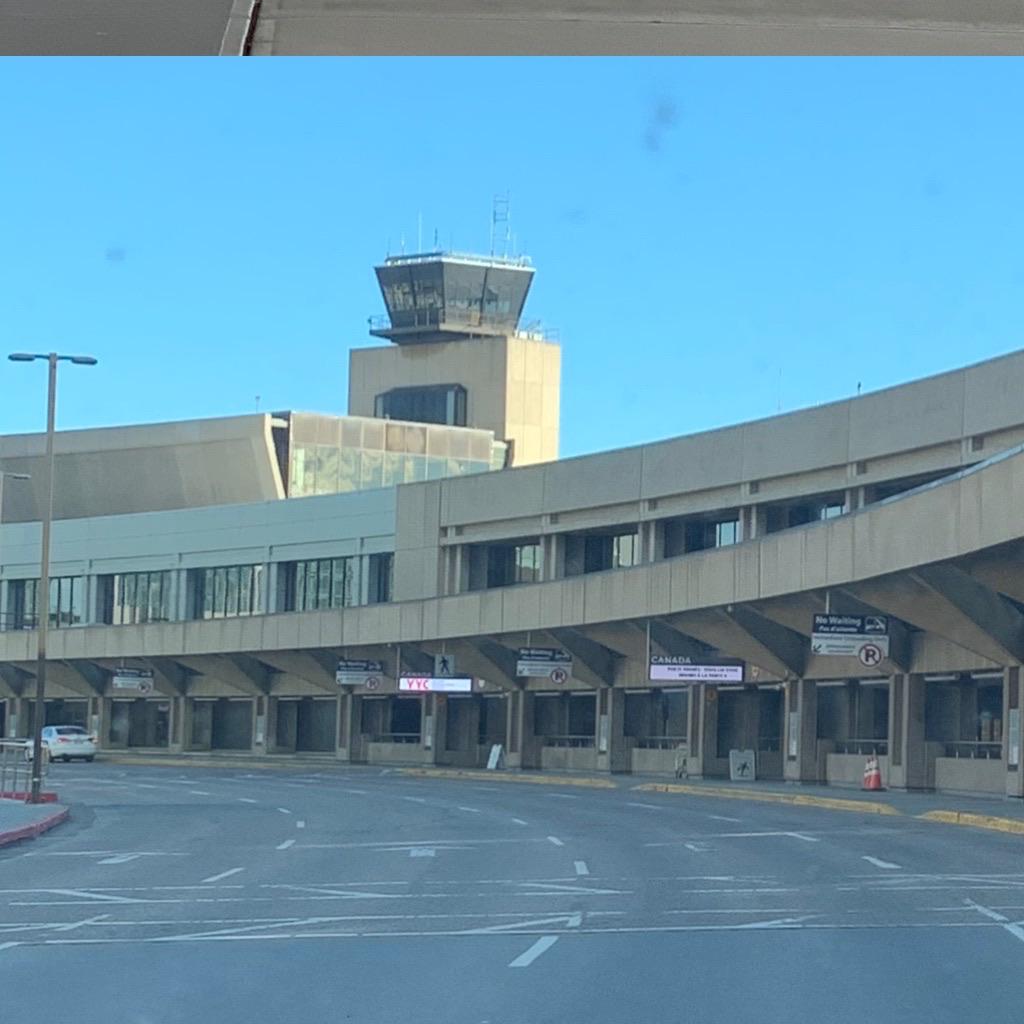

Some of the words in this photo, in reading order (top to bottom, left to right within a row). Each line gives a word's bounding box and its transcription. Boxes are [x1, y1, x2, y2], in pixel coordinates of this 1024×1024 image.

[815, 616, 828, 624] No
[829, 616, 861, 627] Waiting
[651, 656, 691, 664] CANADA
[407, 678, 429, 689] YYC
